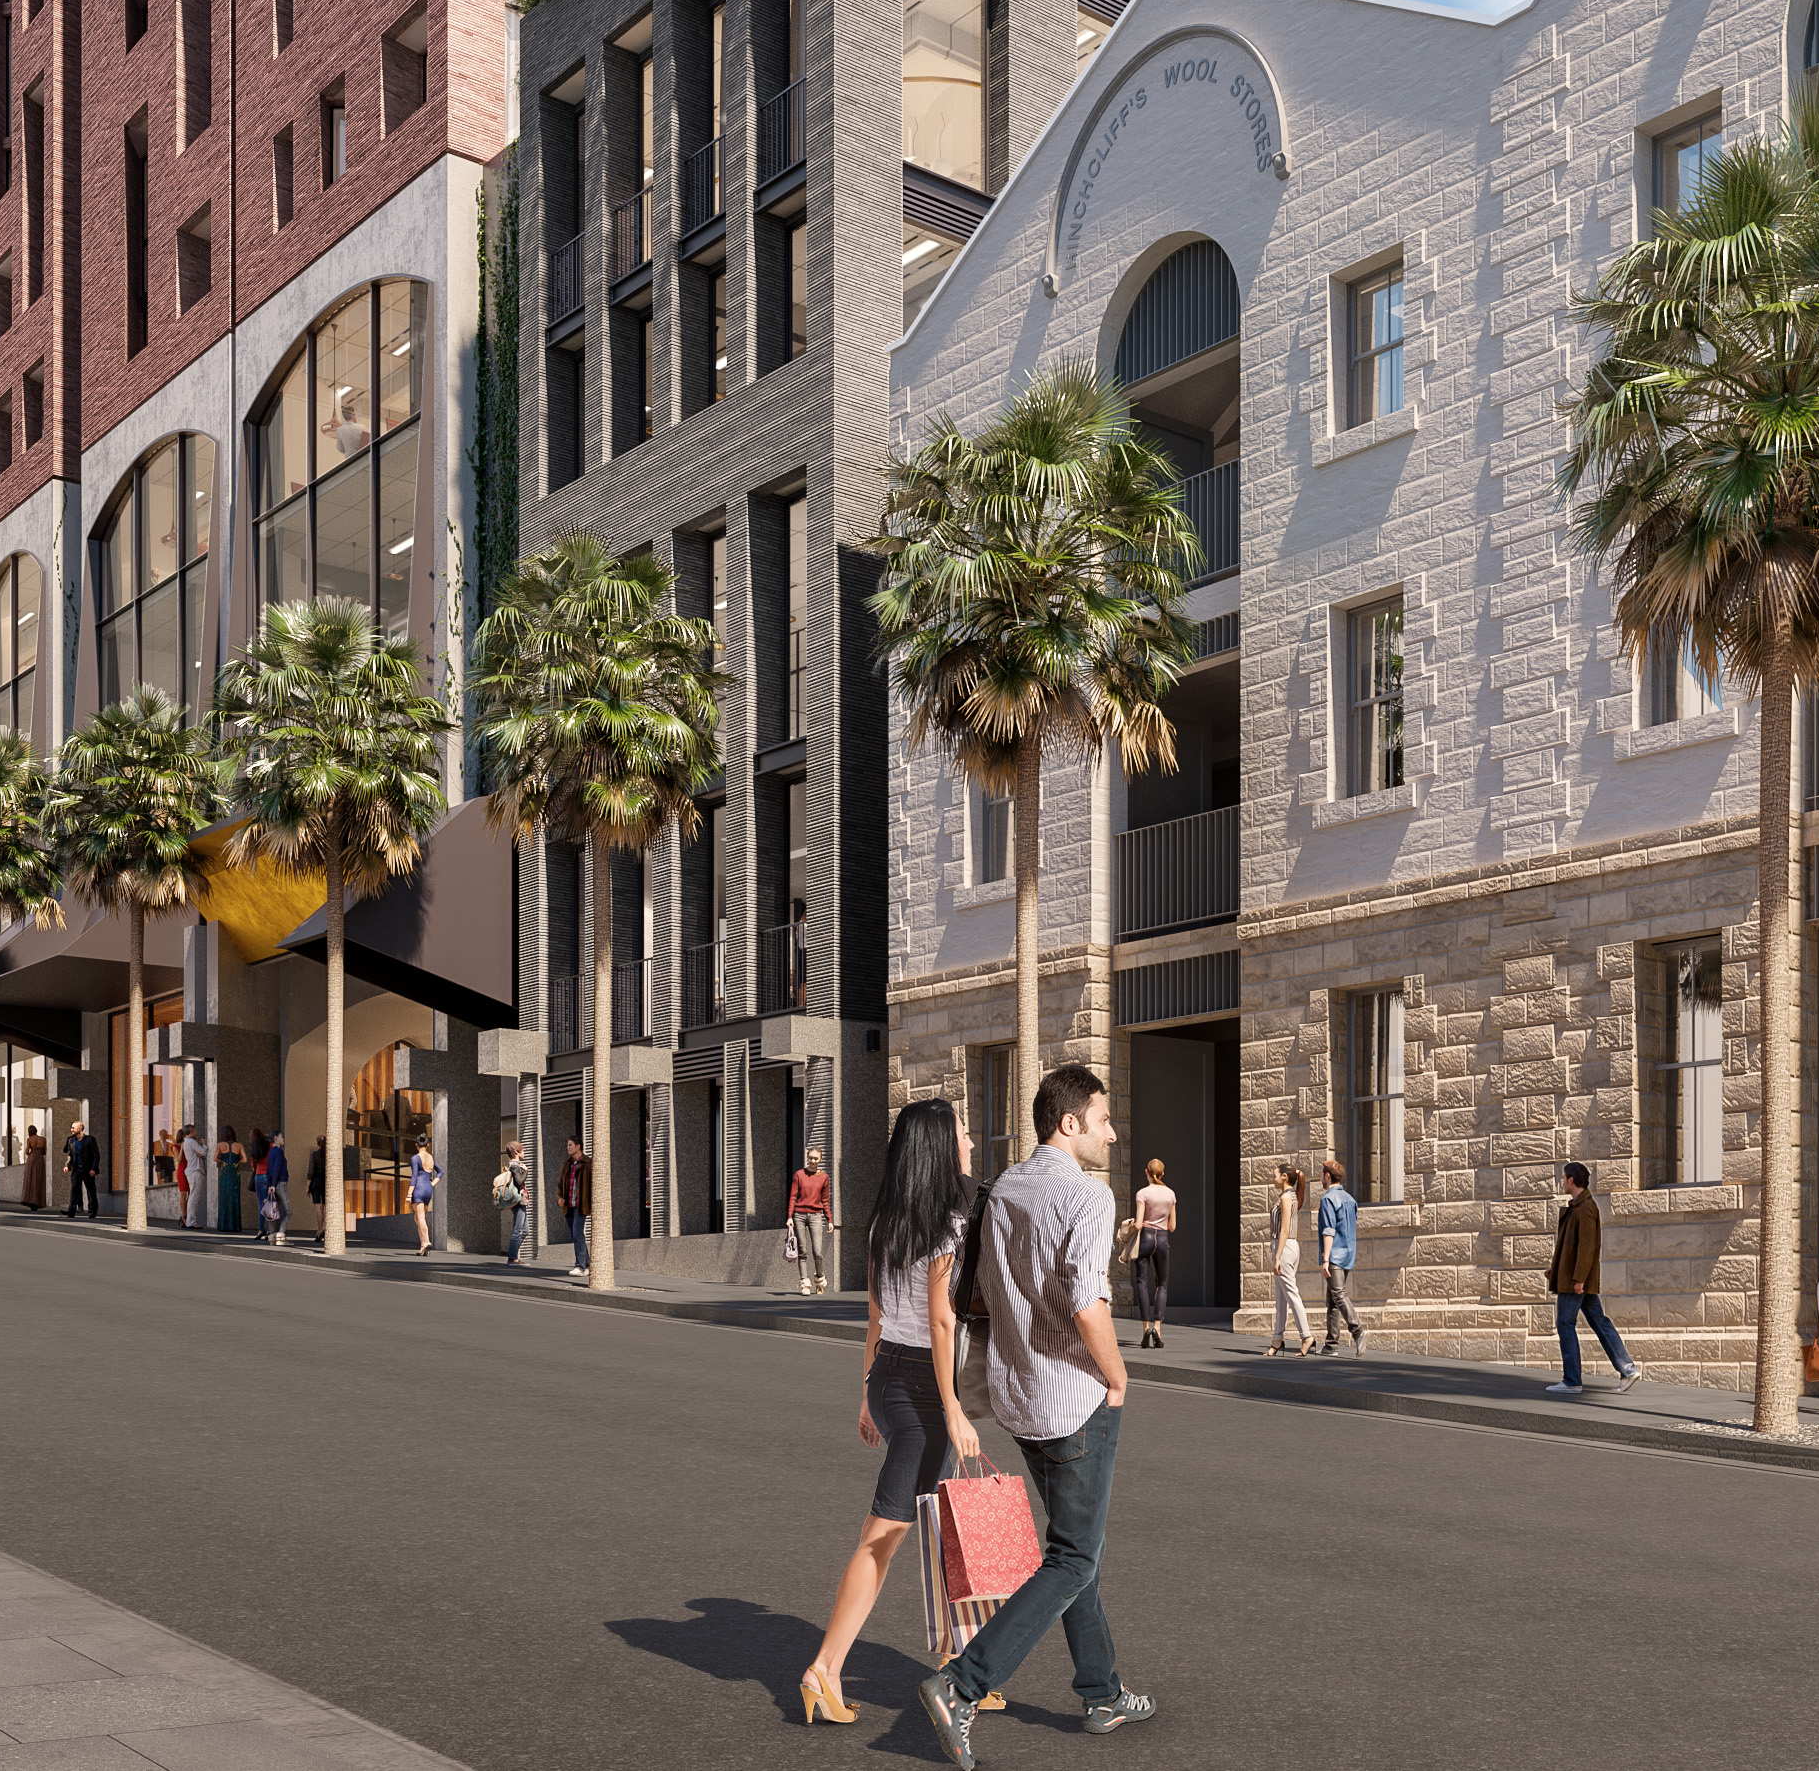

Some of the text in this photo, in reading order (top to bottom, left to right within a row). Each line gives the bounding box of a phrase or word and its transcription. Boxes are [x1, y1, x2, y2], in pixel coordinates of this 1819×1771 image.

[1065, 58, 1272, 271] HINCHCLIFF'S WOOL STORES
